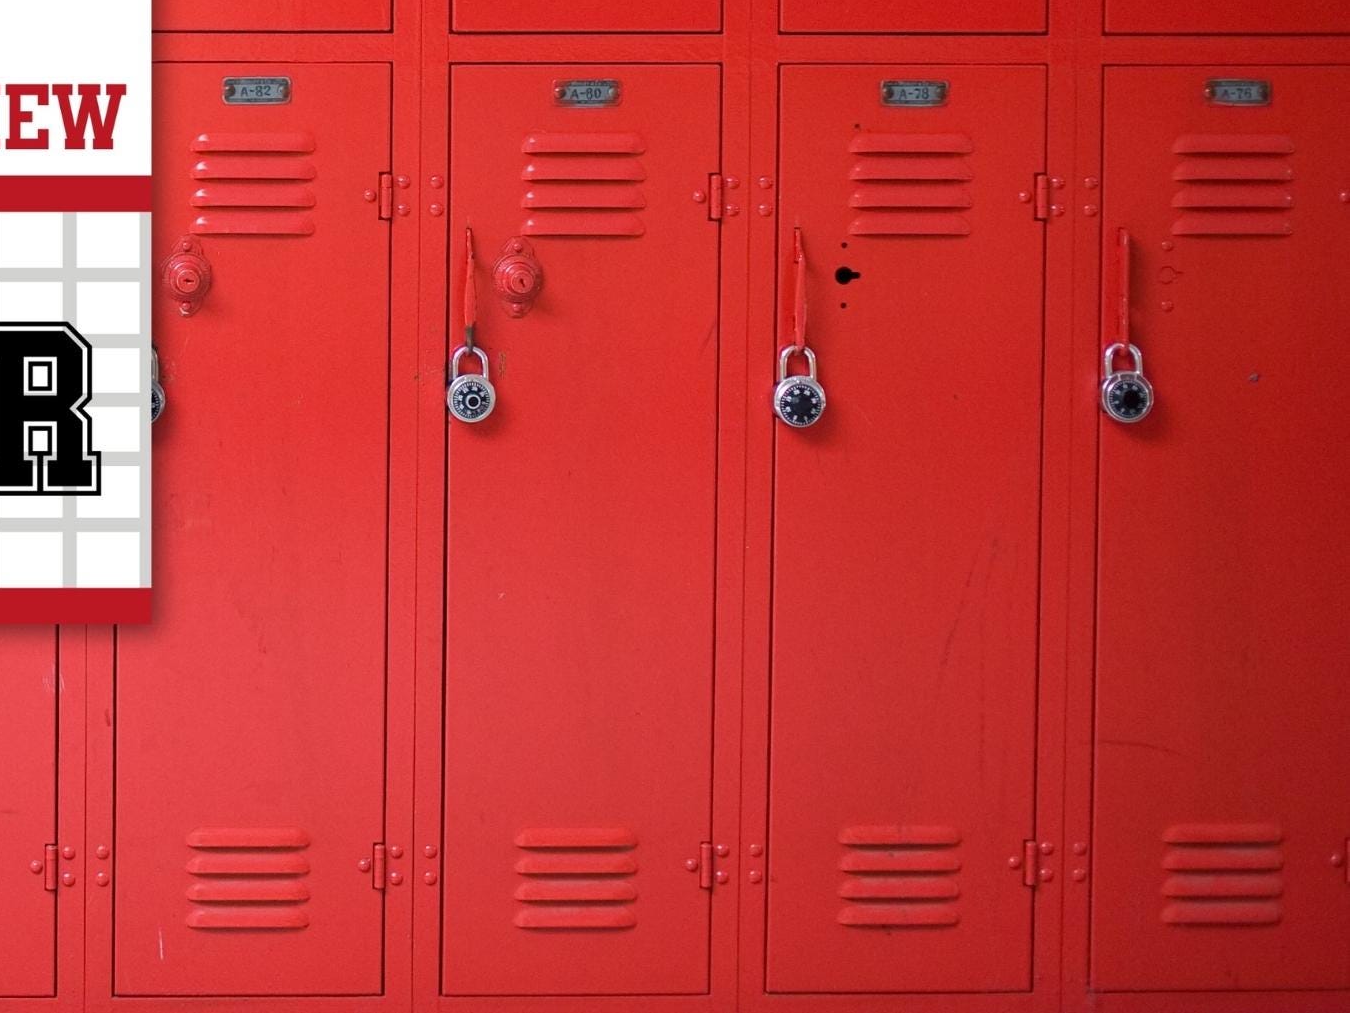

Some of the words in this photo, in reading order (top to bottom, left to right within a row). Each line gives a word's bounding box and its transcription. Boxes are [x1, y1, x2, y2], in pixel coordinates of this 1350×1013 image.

[240, 84, 271, 97] A-82
[570, 87, 602, 100] A-80
[898, 87, 930, 99] A-78
[1221, 86, 1252, 99] A-76
